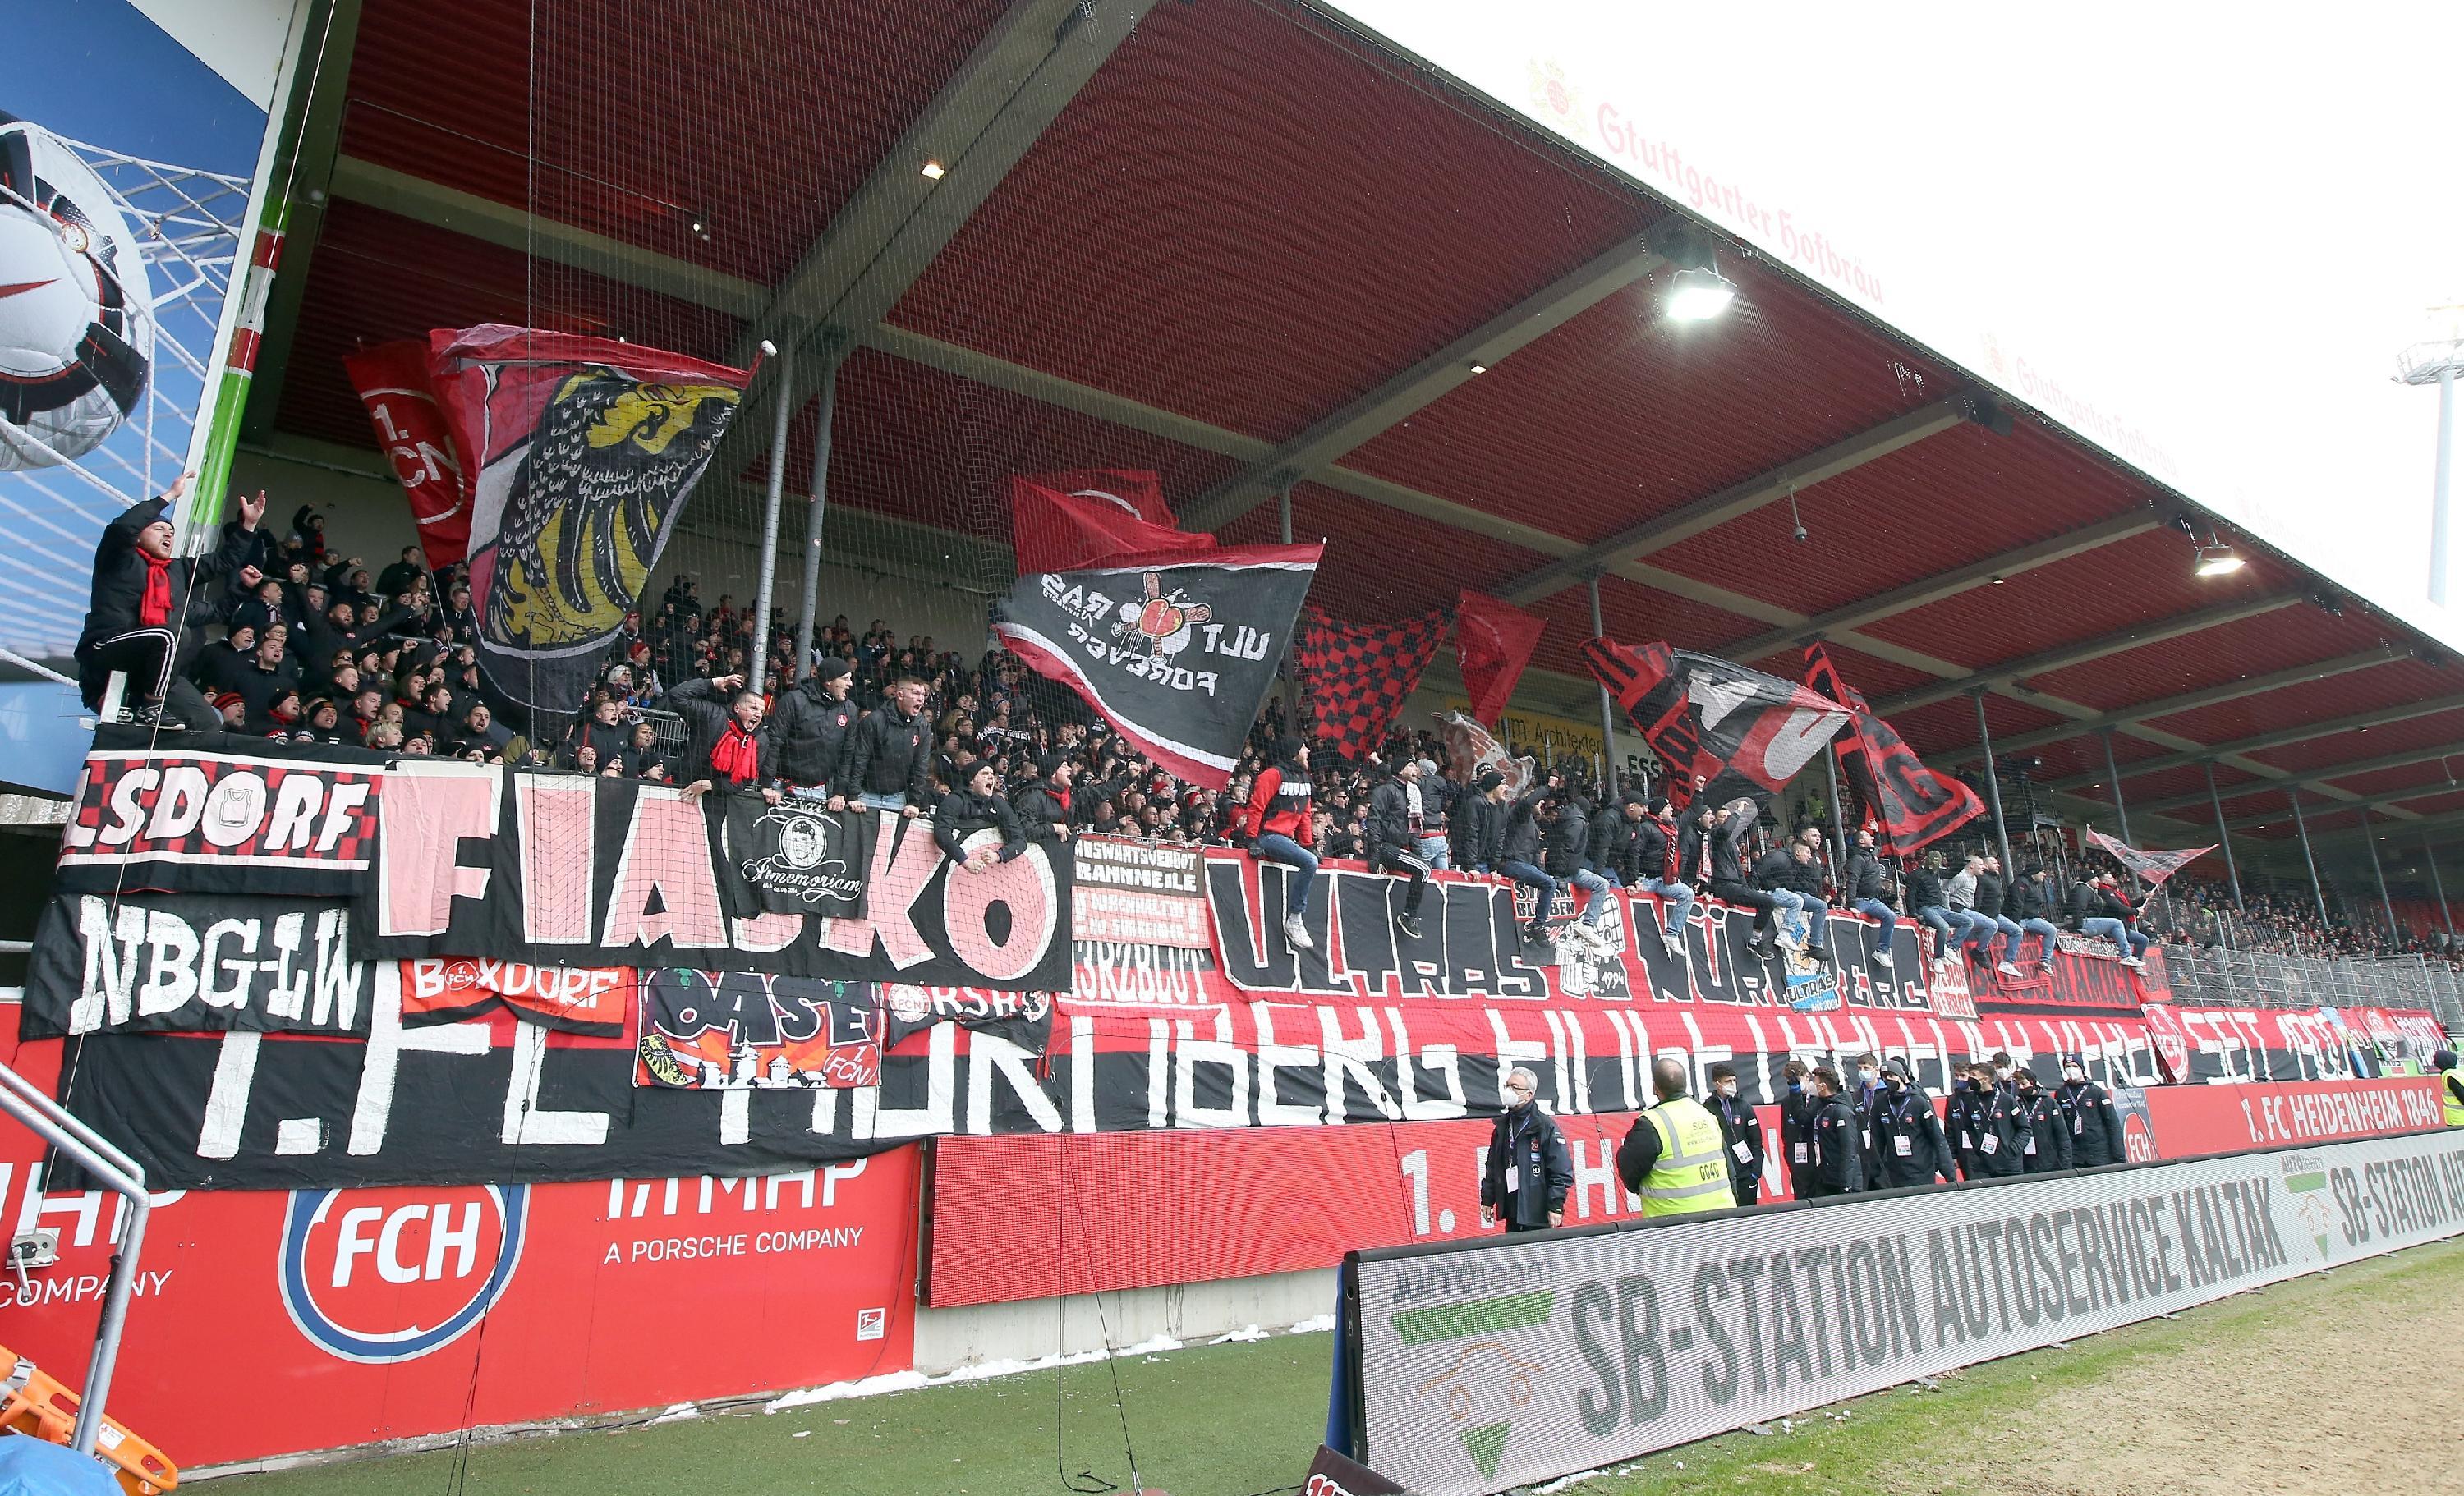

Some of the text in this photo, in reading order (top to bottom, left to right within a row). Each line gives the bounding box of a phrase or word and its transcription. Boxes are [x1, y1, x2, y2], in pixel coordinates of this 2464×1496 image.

[1597, 102, 1884, 304] Stuttgarter Hofbräu
[1075, 860, 1198, 893] BANNMEILE
[1204, 856, 1551, 1000] ULTRAS
[1516, 900, 1576, 918] BLBEN
[1602, 971, 1625, 990] 1994
[1786, 973, 1833, 1002] ULTRAS
[899, 1000, 922, 1011] FCN
[2179, 1011, 2273, 1083] SEIT
[827, 1056, 870, 1084] FCN
[2241, 1087, 2440, 1143] 1. FC HEIDENHEIM 1846
[2127, 1132, 2152, 1163] FCH
[2329, 1153, 2450, 1247] SB-STATION
[331, 1201, 482, 1288] FCH
[603, 1227, 865, 1265] A PORSCHE COMPANY
[1570, 1174, 2288, 1438] SB-STATION AUTOSERVICE KALTAK
